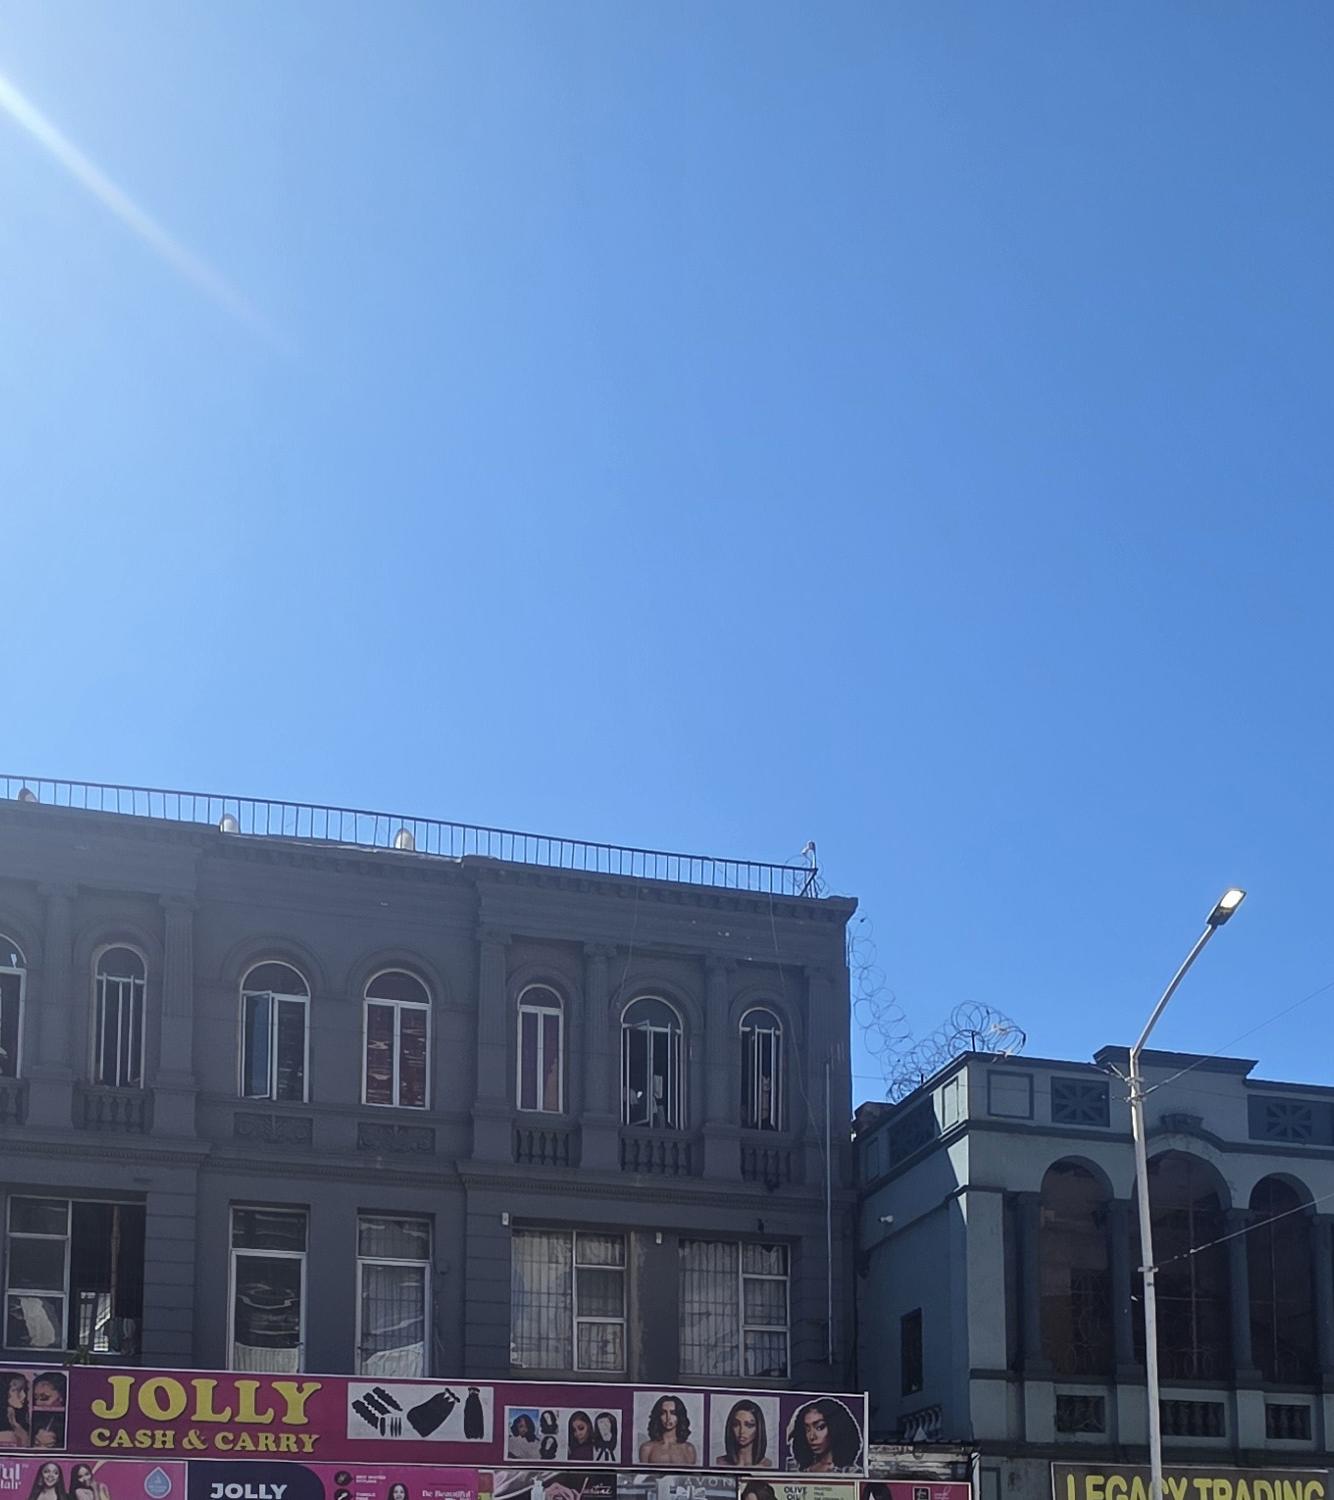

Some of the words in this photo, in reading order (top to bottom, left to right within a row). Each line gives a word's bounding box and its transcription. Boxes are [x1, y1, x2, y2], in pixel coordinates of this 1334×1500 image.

[91, 1375, 322, 1425] JOLLY
[90, 1428, 175, 1449] CASH
[183, 1429, 208, 1450] &
[214, 1431, 320, 1453] CARRY
[685, 1477, 735, 1488] AVON
[784, 1486, 807, 1494] OLIVE
[210, 1483, 288, 1499] JOLLY
